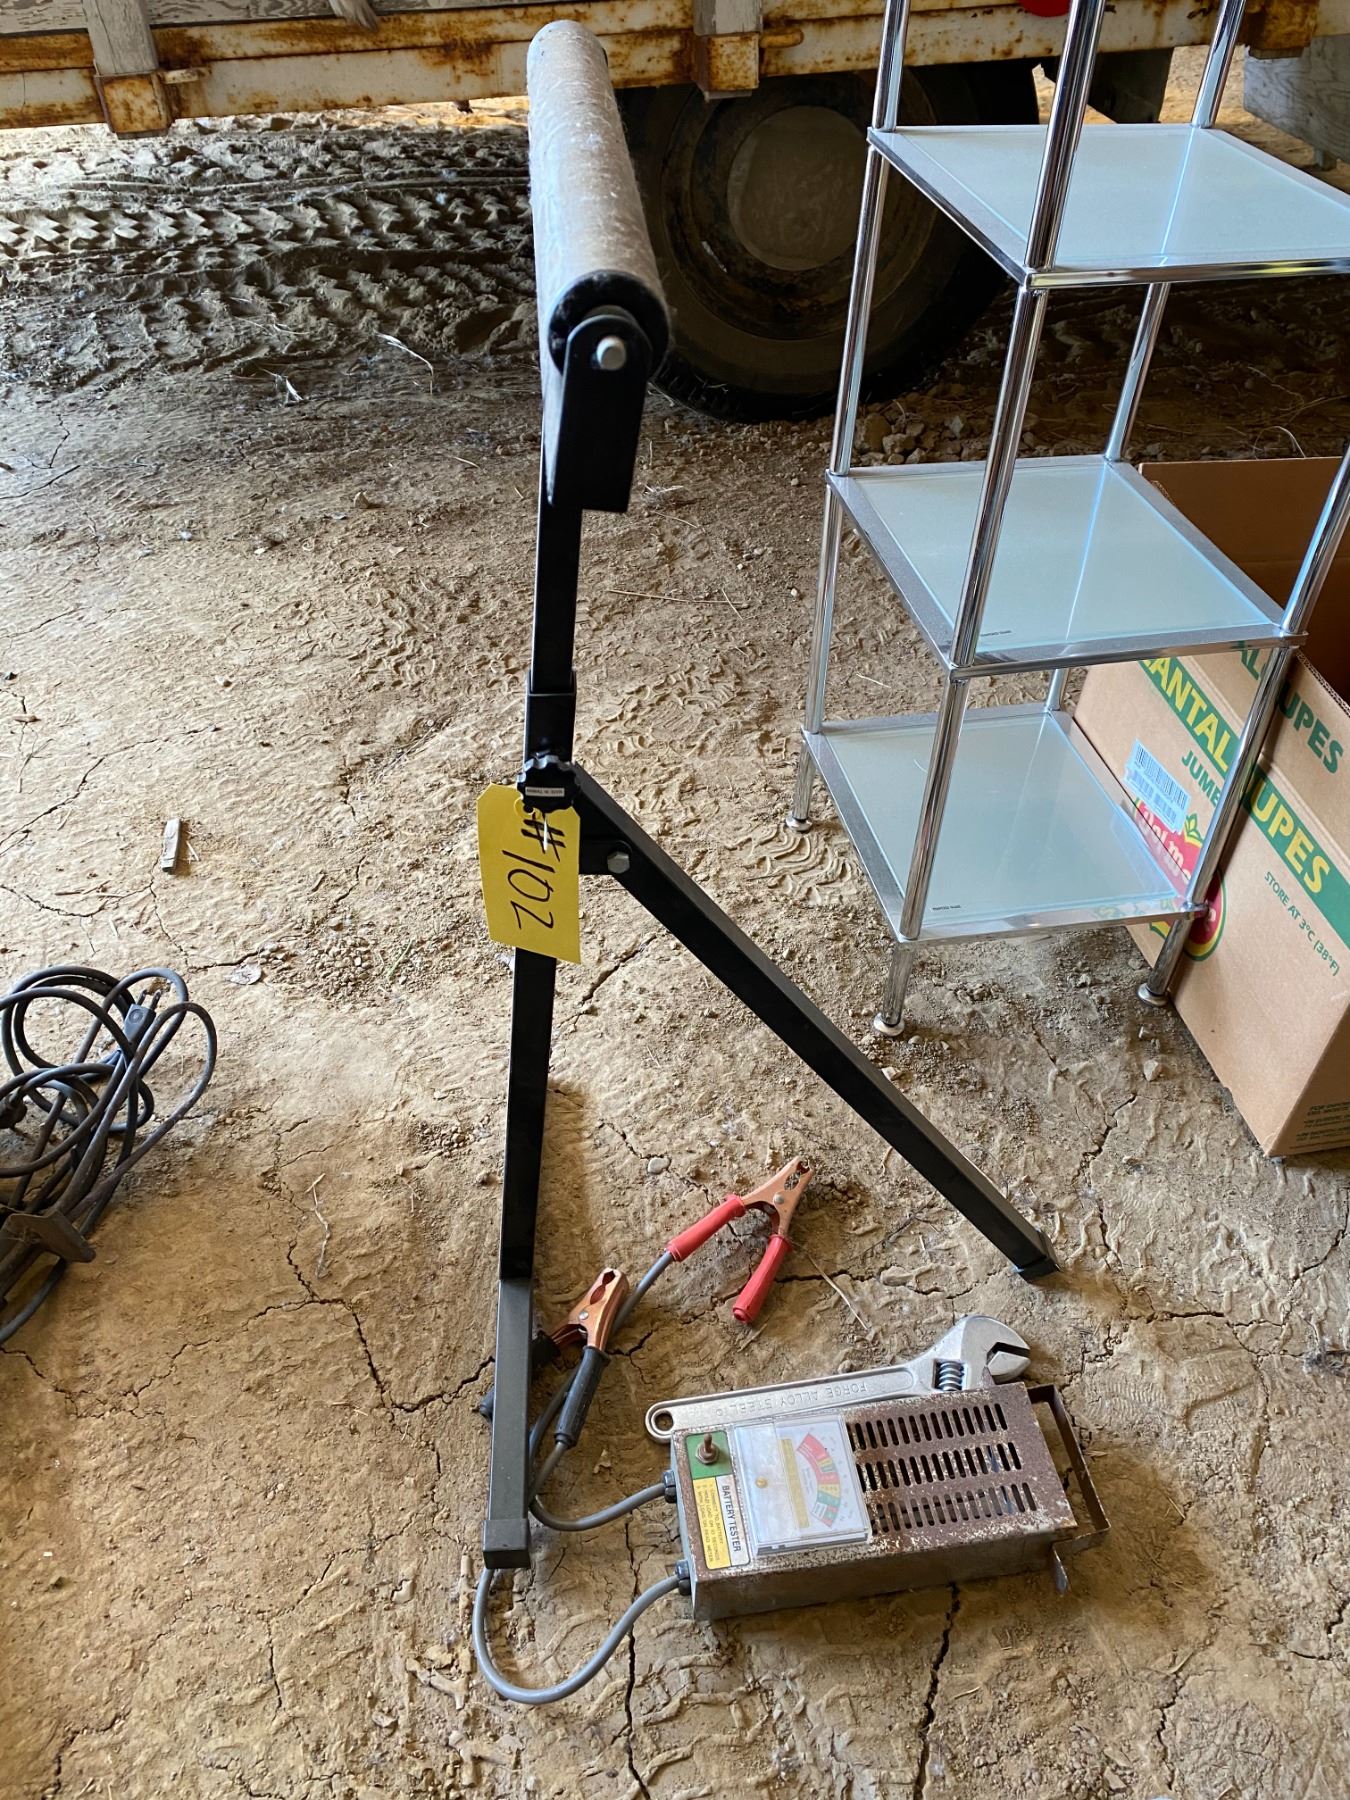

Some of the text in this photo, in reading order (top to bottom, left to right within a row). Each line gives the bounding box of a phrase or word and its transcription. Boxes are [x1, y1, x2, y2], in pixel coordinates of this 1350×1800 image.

[501, 812, 566, 930] #102
[1264, 871, 1290, 906] STORE
[1288, 905, 1301, 920] AT
[729, 1381, 868, 1415] FORGE ALLOY STEEL
[722, 1484, 742, 1552] BATTERY TESTER
